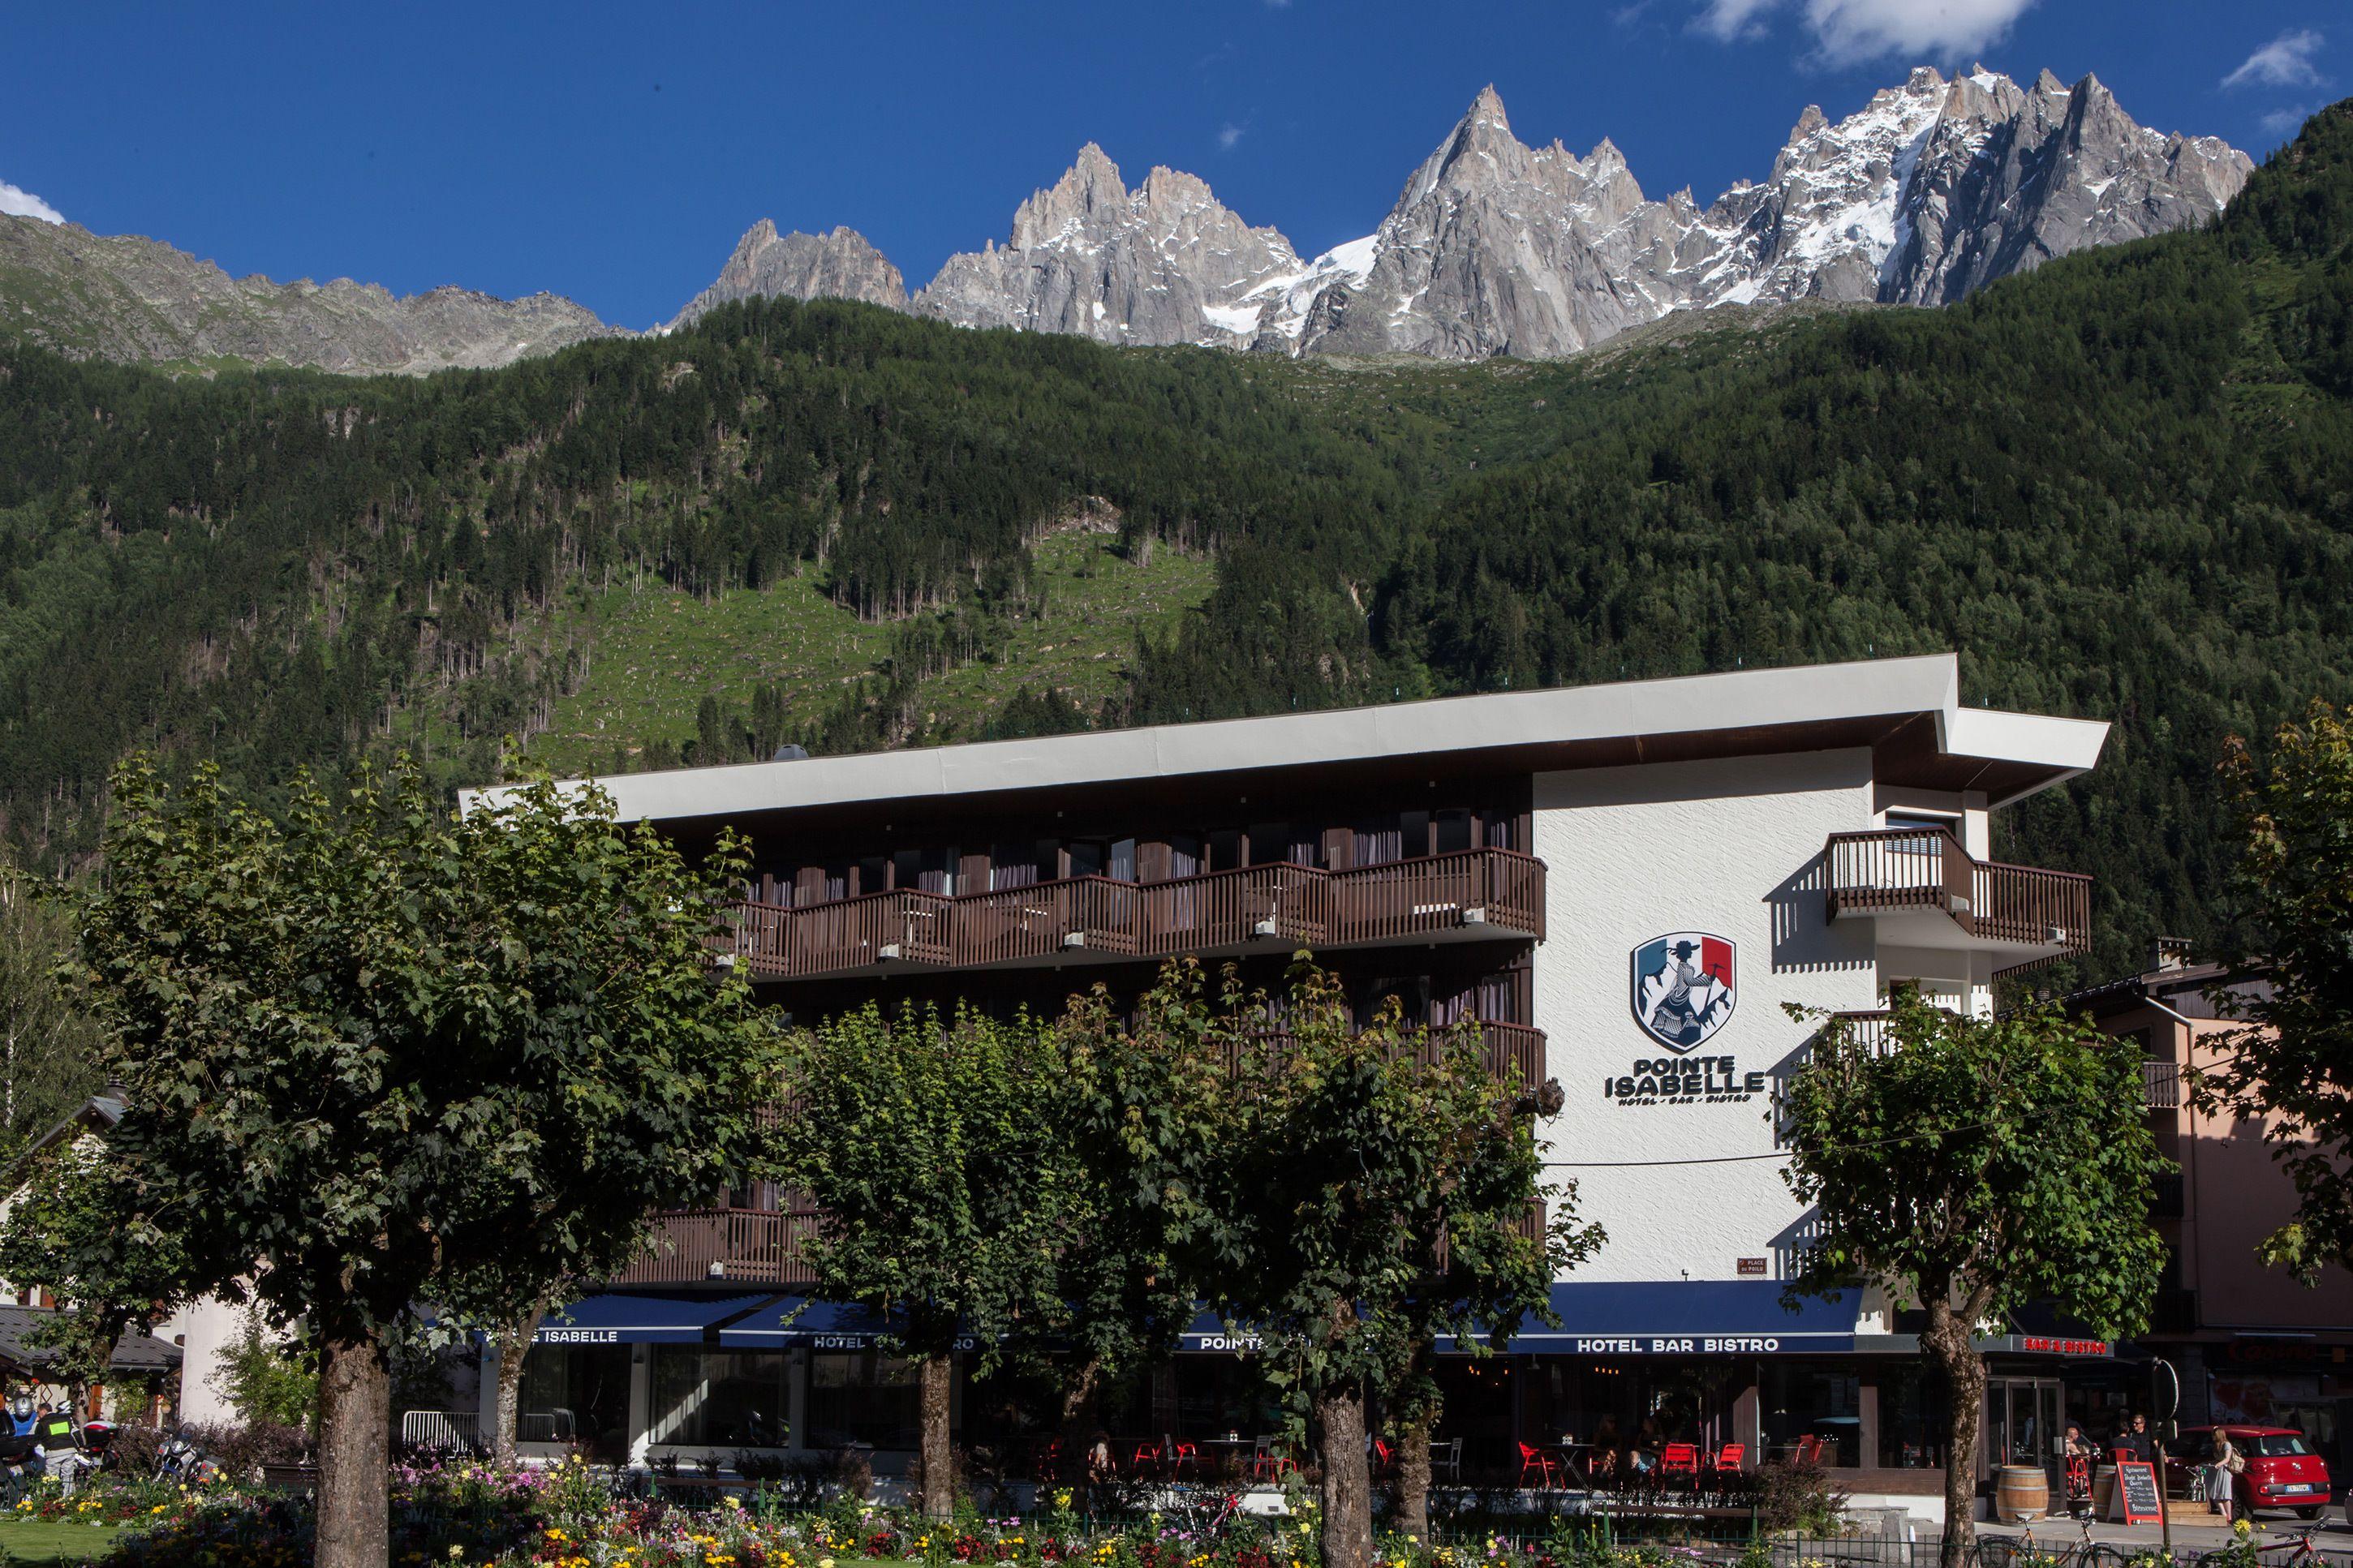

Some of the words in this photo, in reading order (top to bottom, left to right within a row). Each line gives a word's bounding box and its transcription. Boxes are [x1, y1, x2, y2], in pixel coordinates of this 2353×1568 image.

[1633, 1056, 1735, 1077] POINTE
[1605, 1072, 1765, 1098] ISABELLE
[1618, 1098, 1658, 1106] HOTEL
[1668, 1096, 1694, 1105] BAR
[1706, 1093, 1751, 1103] BISTRO
[545, 1331, 617, 1342] ISABELLE
[814, 1337, 865, 1350] HOTEL
[1577, 1339, 1643, 1352] HOTEL
[1652, 1339, 1694, 1352] BAR
[1704, 1338, 1779, 1351] BISTRO
[2024, 1338, 2049, 1351] BAR
[2063, 1340, 2106, 1355] BISTRO
